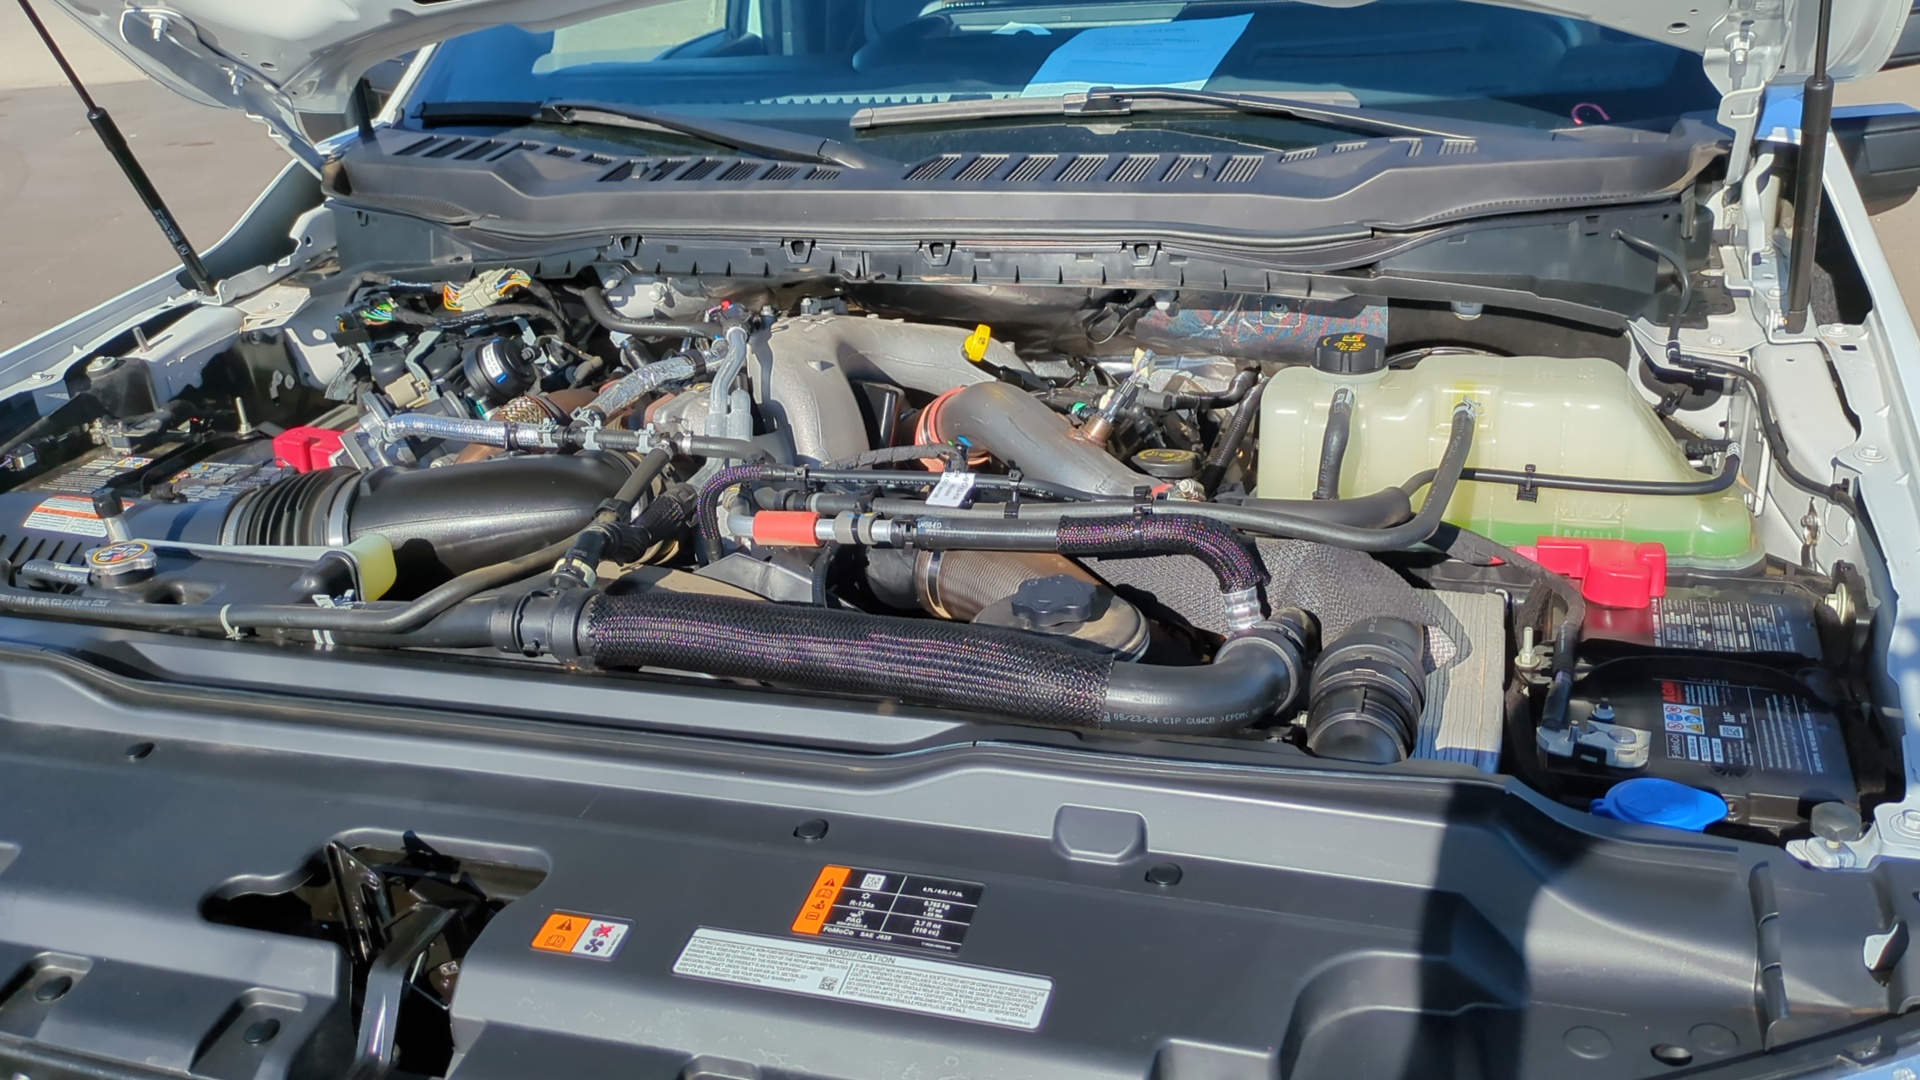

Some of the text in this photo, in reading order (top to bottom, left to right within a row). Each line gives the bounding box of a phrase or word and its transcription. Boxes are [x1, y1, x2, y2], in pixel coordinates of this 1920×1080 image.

[1114, 713, 1158, 724] 05/23/24
[848, 899, 876, 908] R-134a
[822, 925, 855, 936] FoMoCo
[826, 948, 896, 964] MODIFICATION
